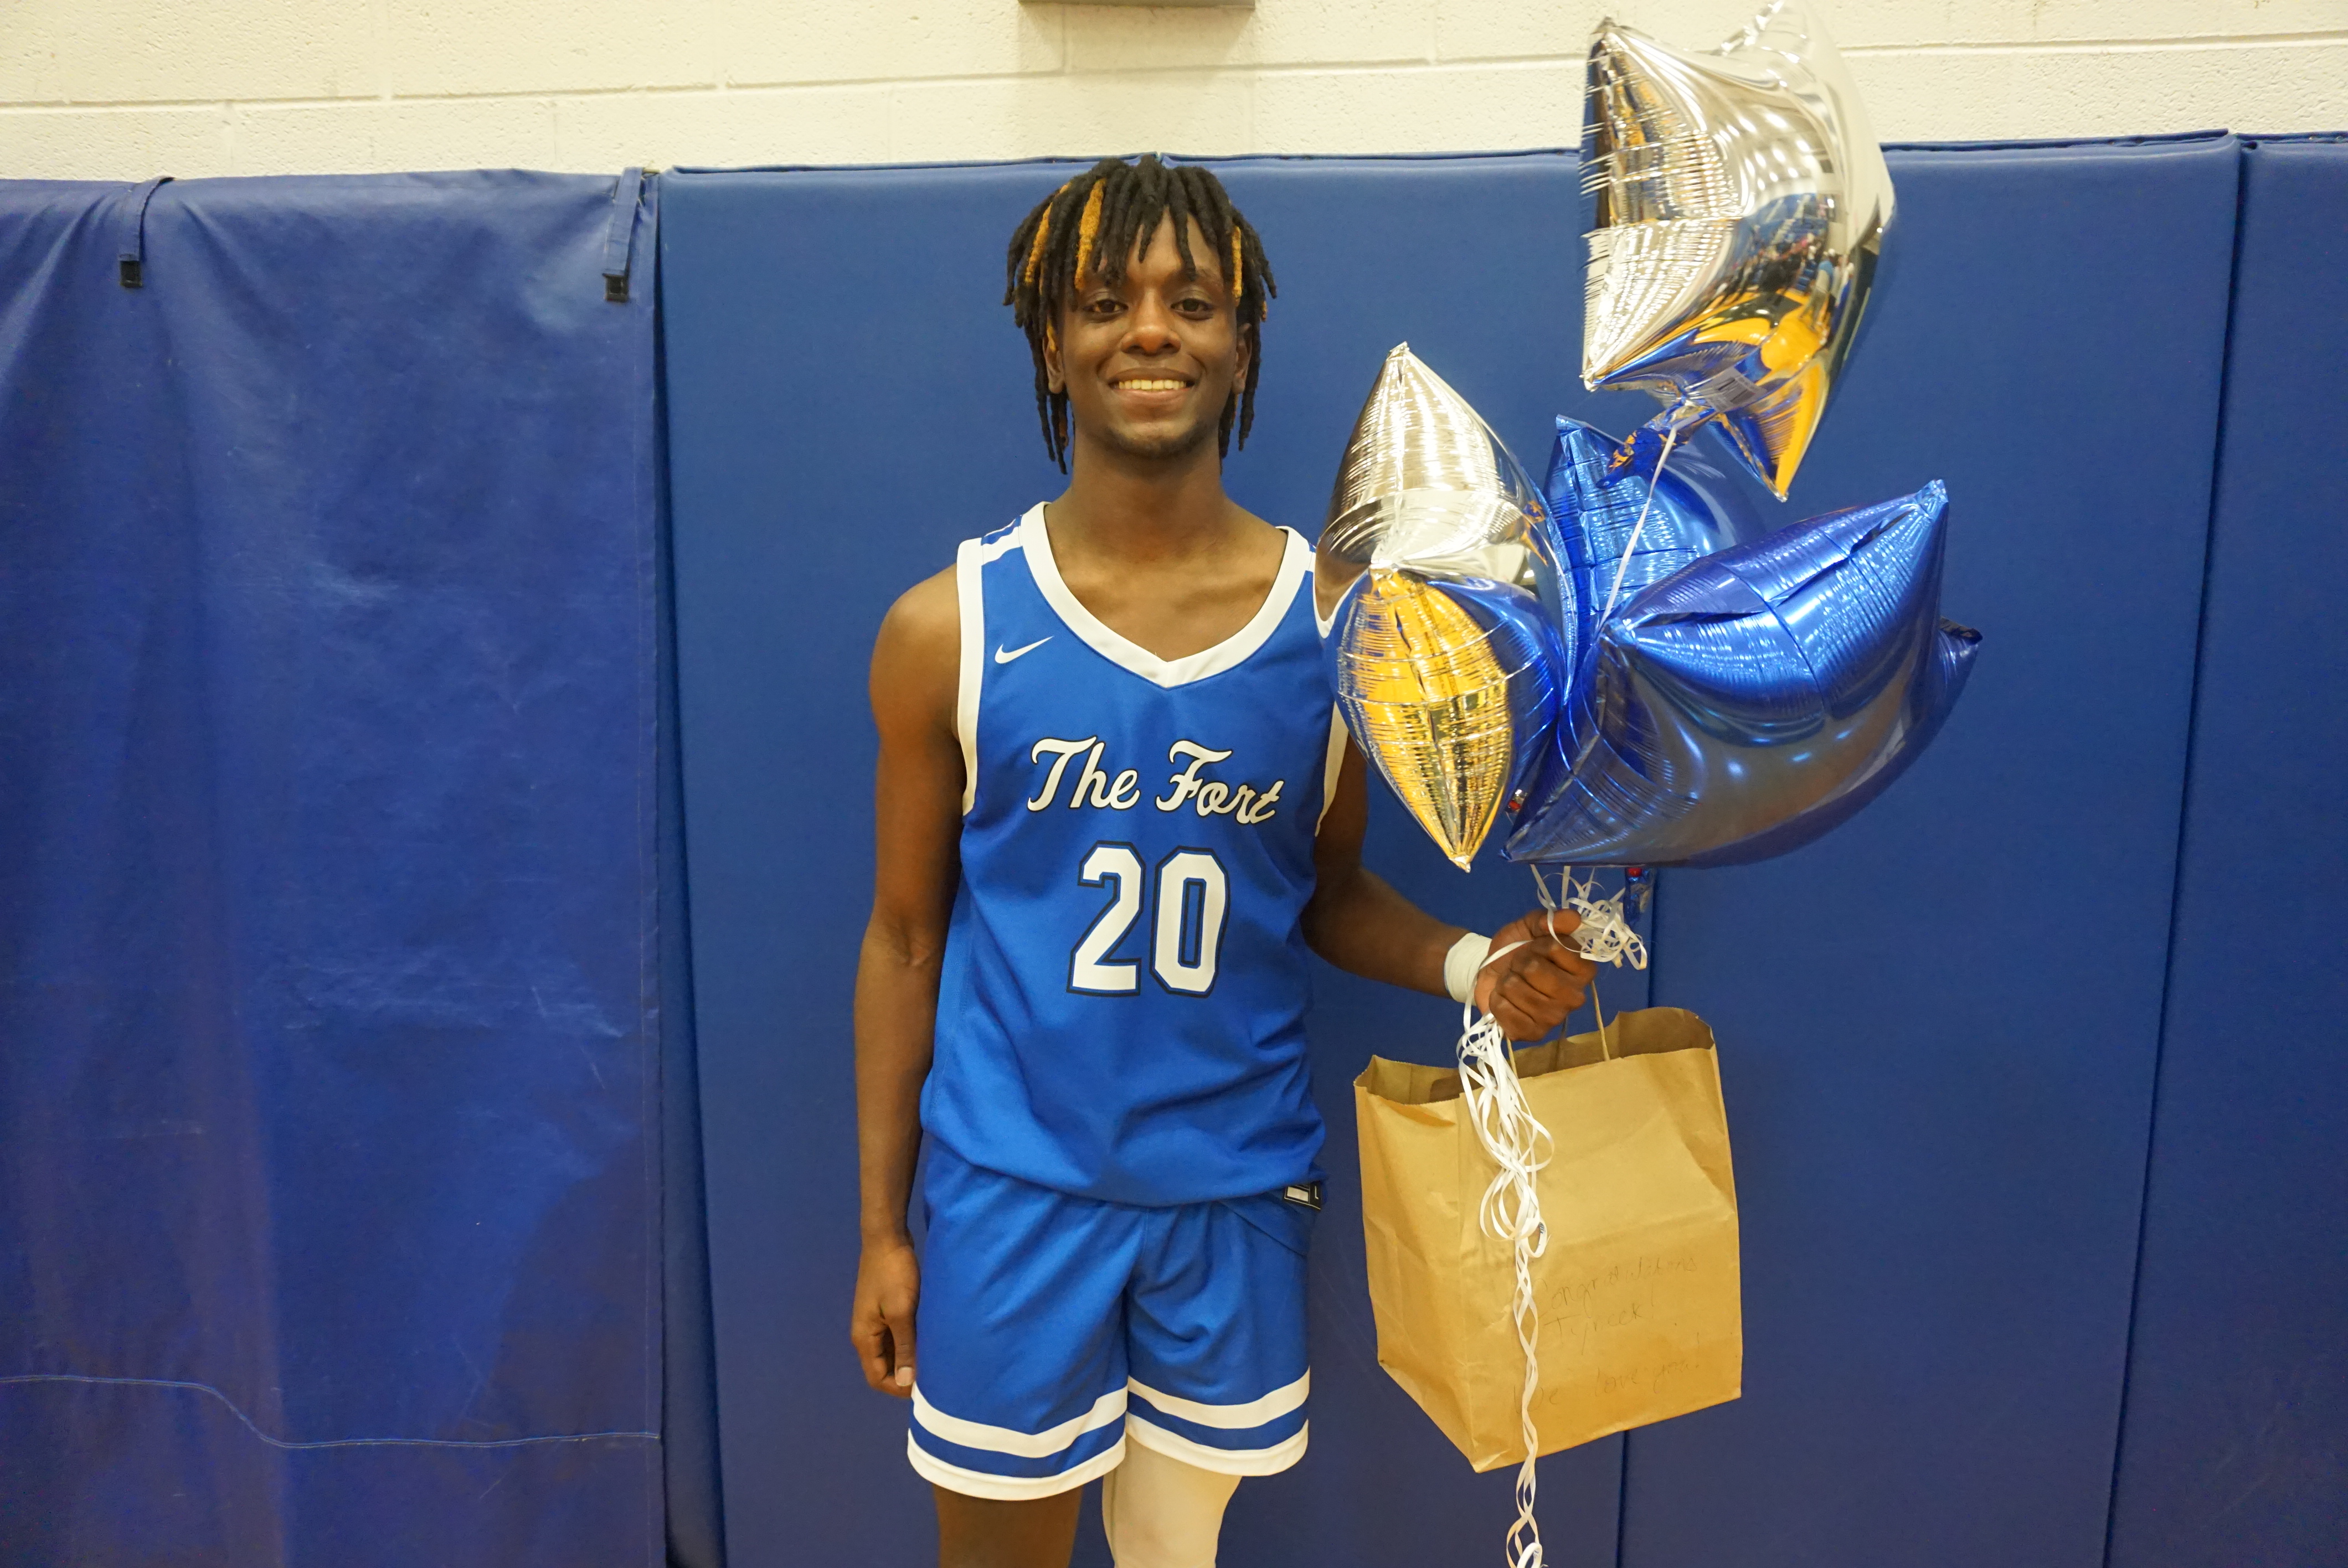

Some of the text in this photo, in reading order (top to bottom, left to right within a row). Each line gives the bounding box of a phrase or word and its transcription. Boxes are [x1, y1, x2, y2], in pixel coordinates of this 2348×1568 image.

[1027, 736, 1285, 825] The Fort
[1067, 840, 1230, 997] 20
